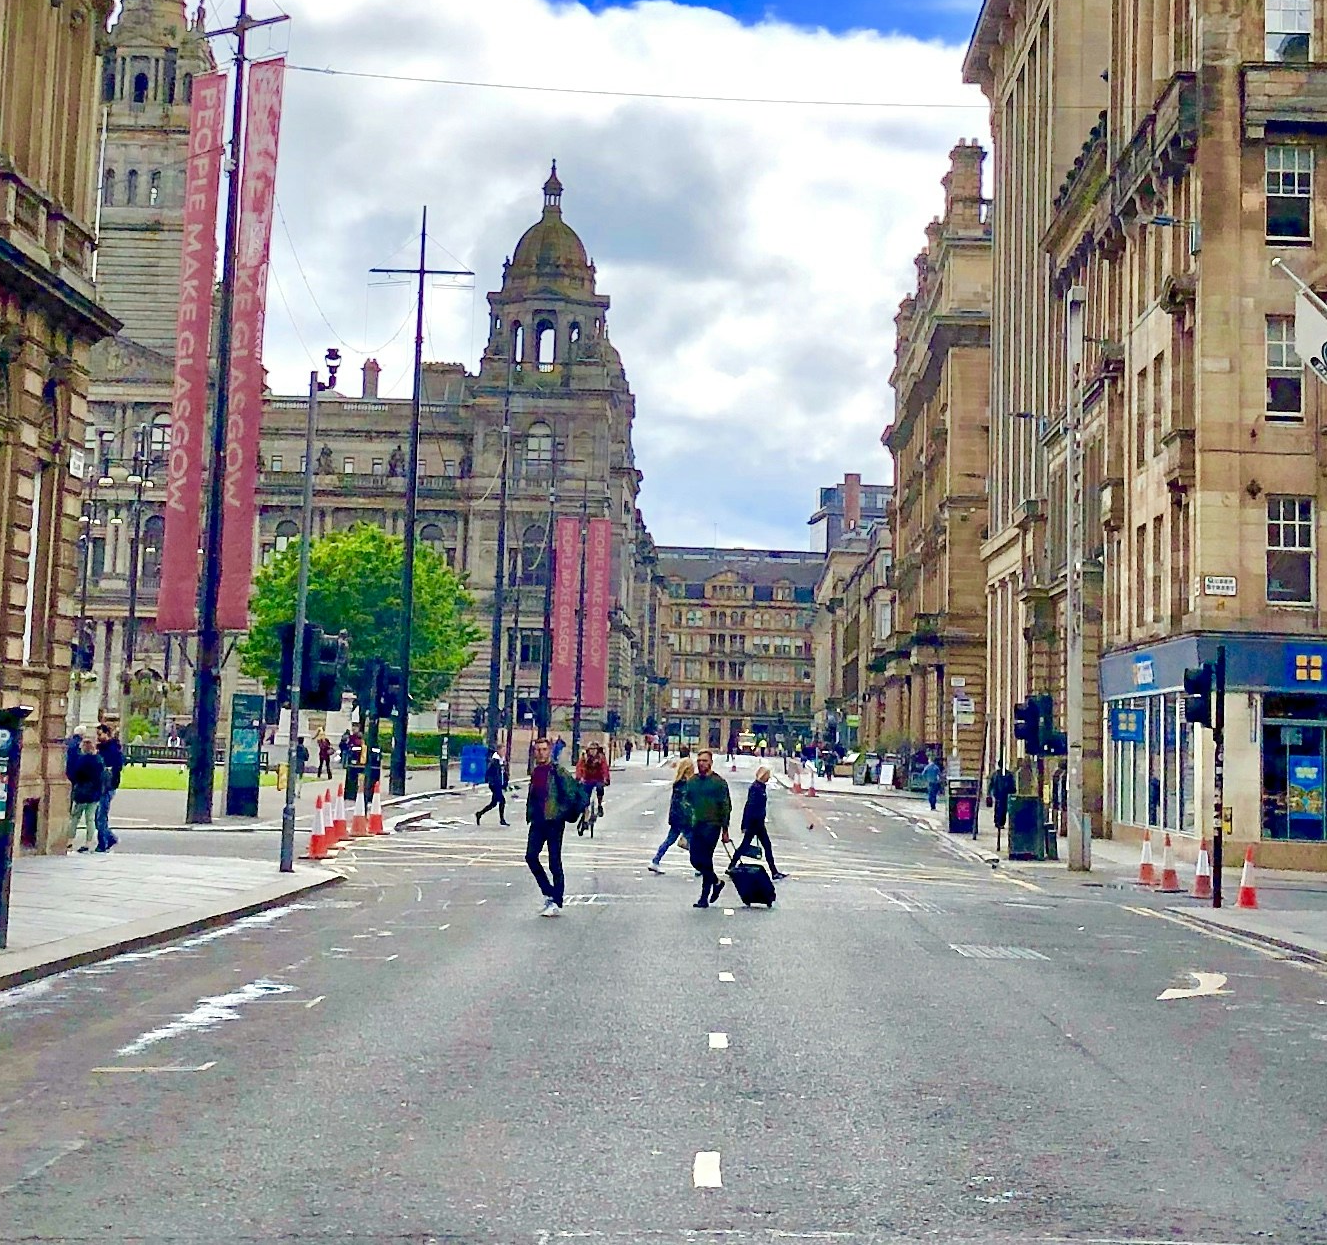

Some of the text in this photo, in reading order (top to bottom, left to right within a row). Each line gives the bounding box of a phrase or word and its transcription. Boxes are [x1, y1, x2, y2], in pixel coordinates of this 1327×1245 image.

[168, 87, 218, 513] PEOPLE MAKE GLASGOW
[223, 321, 251, 508] GLASGOW
[557, 521, 574, 667] PEOPLE MAKE GLASGOW
[590, 523, 606, 668] PEOPLE MAKE GLASGOW
